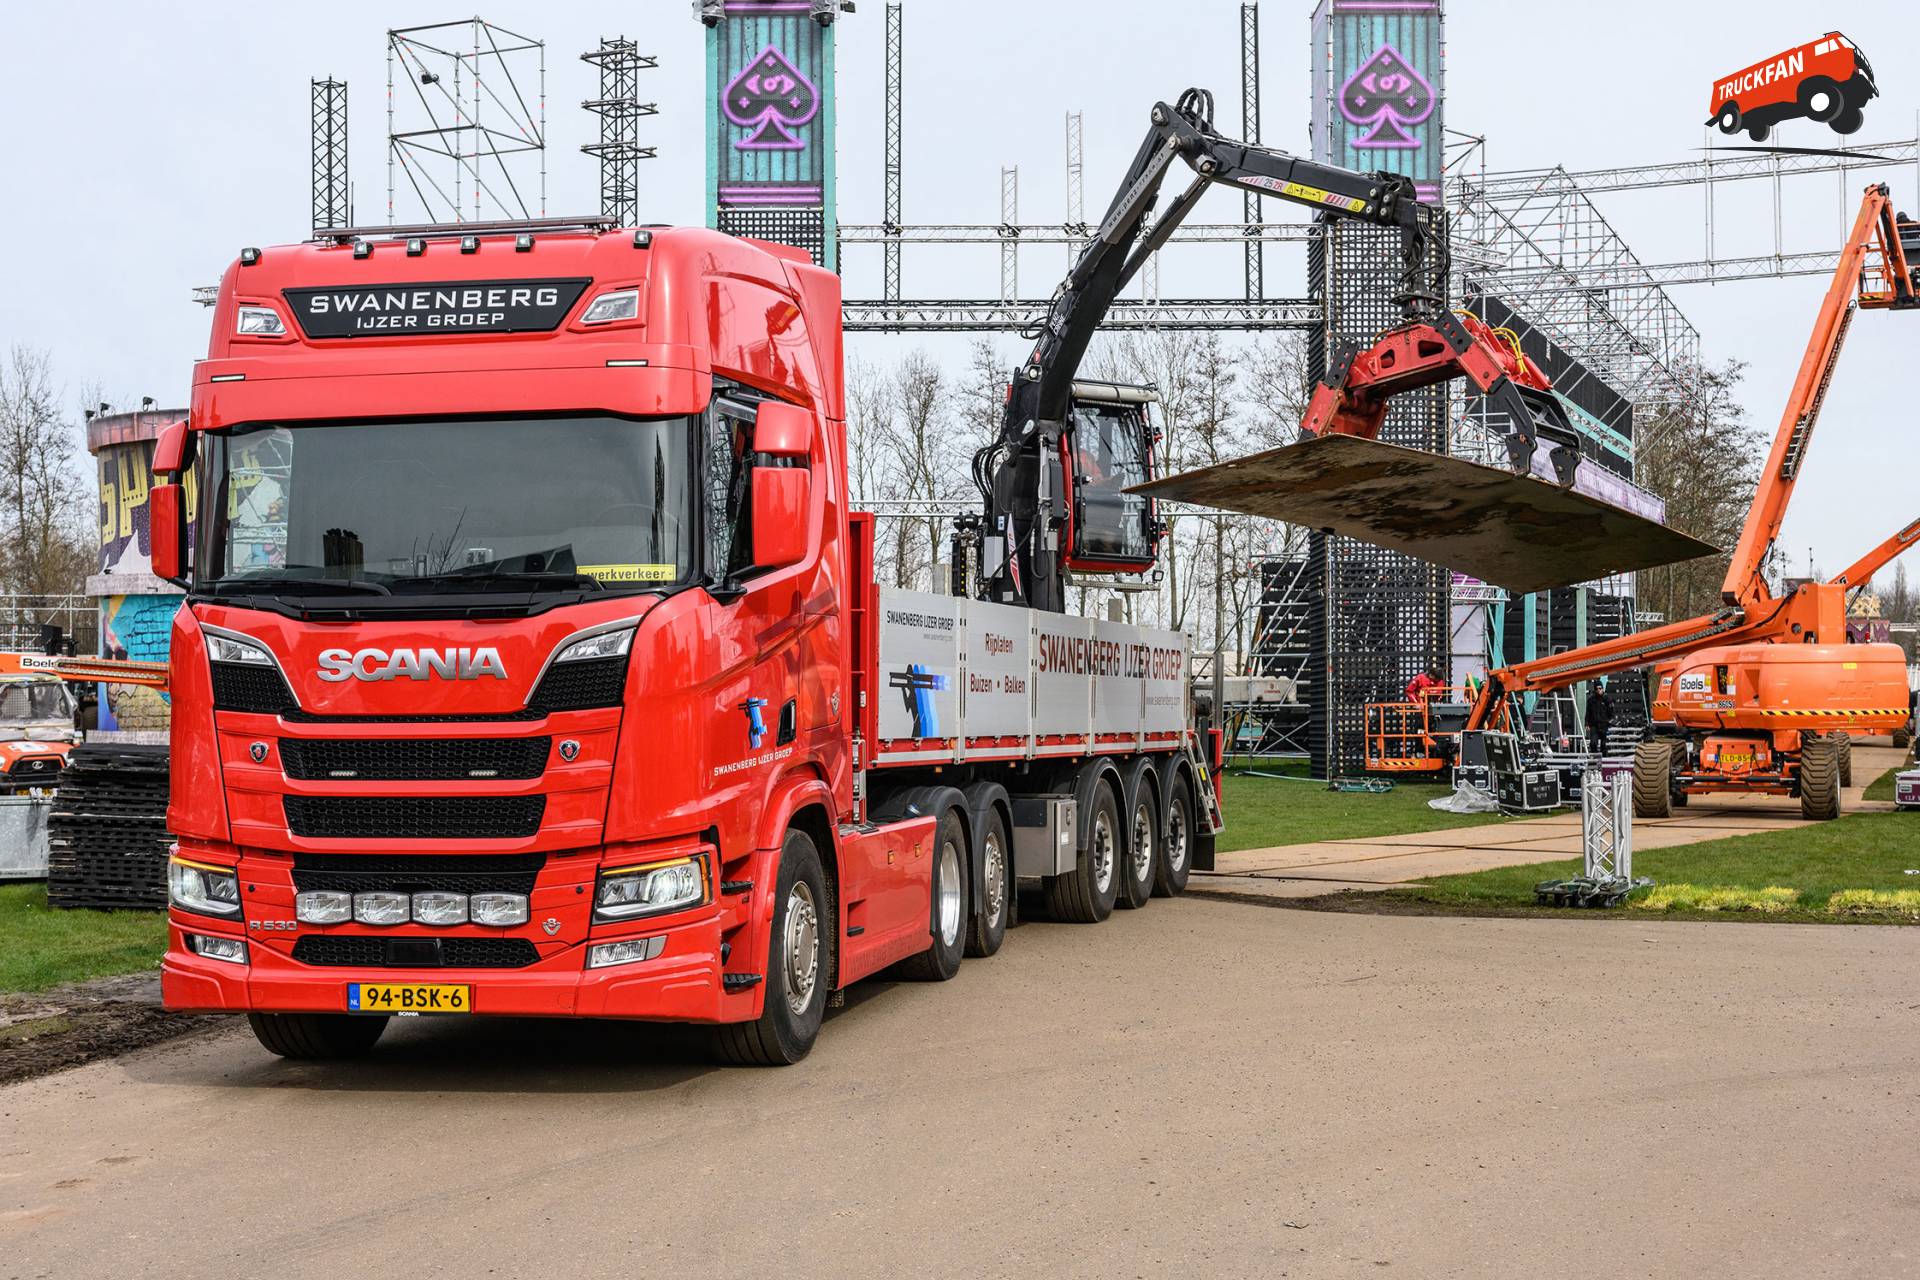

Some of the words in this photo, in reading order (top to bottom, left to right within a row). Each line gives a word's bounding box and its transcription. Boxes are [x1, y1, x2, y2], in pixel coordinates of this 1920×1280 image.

[309, 288, 559, 313] SWANENBERG
[356, 314, 418, 329] IJZER
[427, 312, 505, 327] GROEP
[886, 610, 924, 627] SWANENBERG
[923, 615, 938, 629] IJZER
[938, 617, 954, 631] GROEP
[985, 632, 1013, 656] Rijplaten
[317, 647, 508, 682] SCANIA
[1039, 633, 1120, 677] SWANENBERG
[1124, 643, 1150, 679] IJZER
[1153, 648, 1182, 681] GROEP
[970, 673, 992, 693] Buizen
[1004, 675, 1026, 694] Balken
[1680, 677, 1704, 690] Boels
[713, 757, 757, 777] SWANENBERG
[757, 752, 774, 765] IJZER
[774, 747, 793, 760] GROEP
[249, 920, 261, 931] R
[263, 920, 297, 931] 530
[367, 988, 462, 1008] 94-BSK-6
